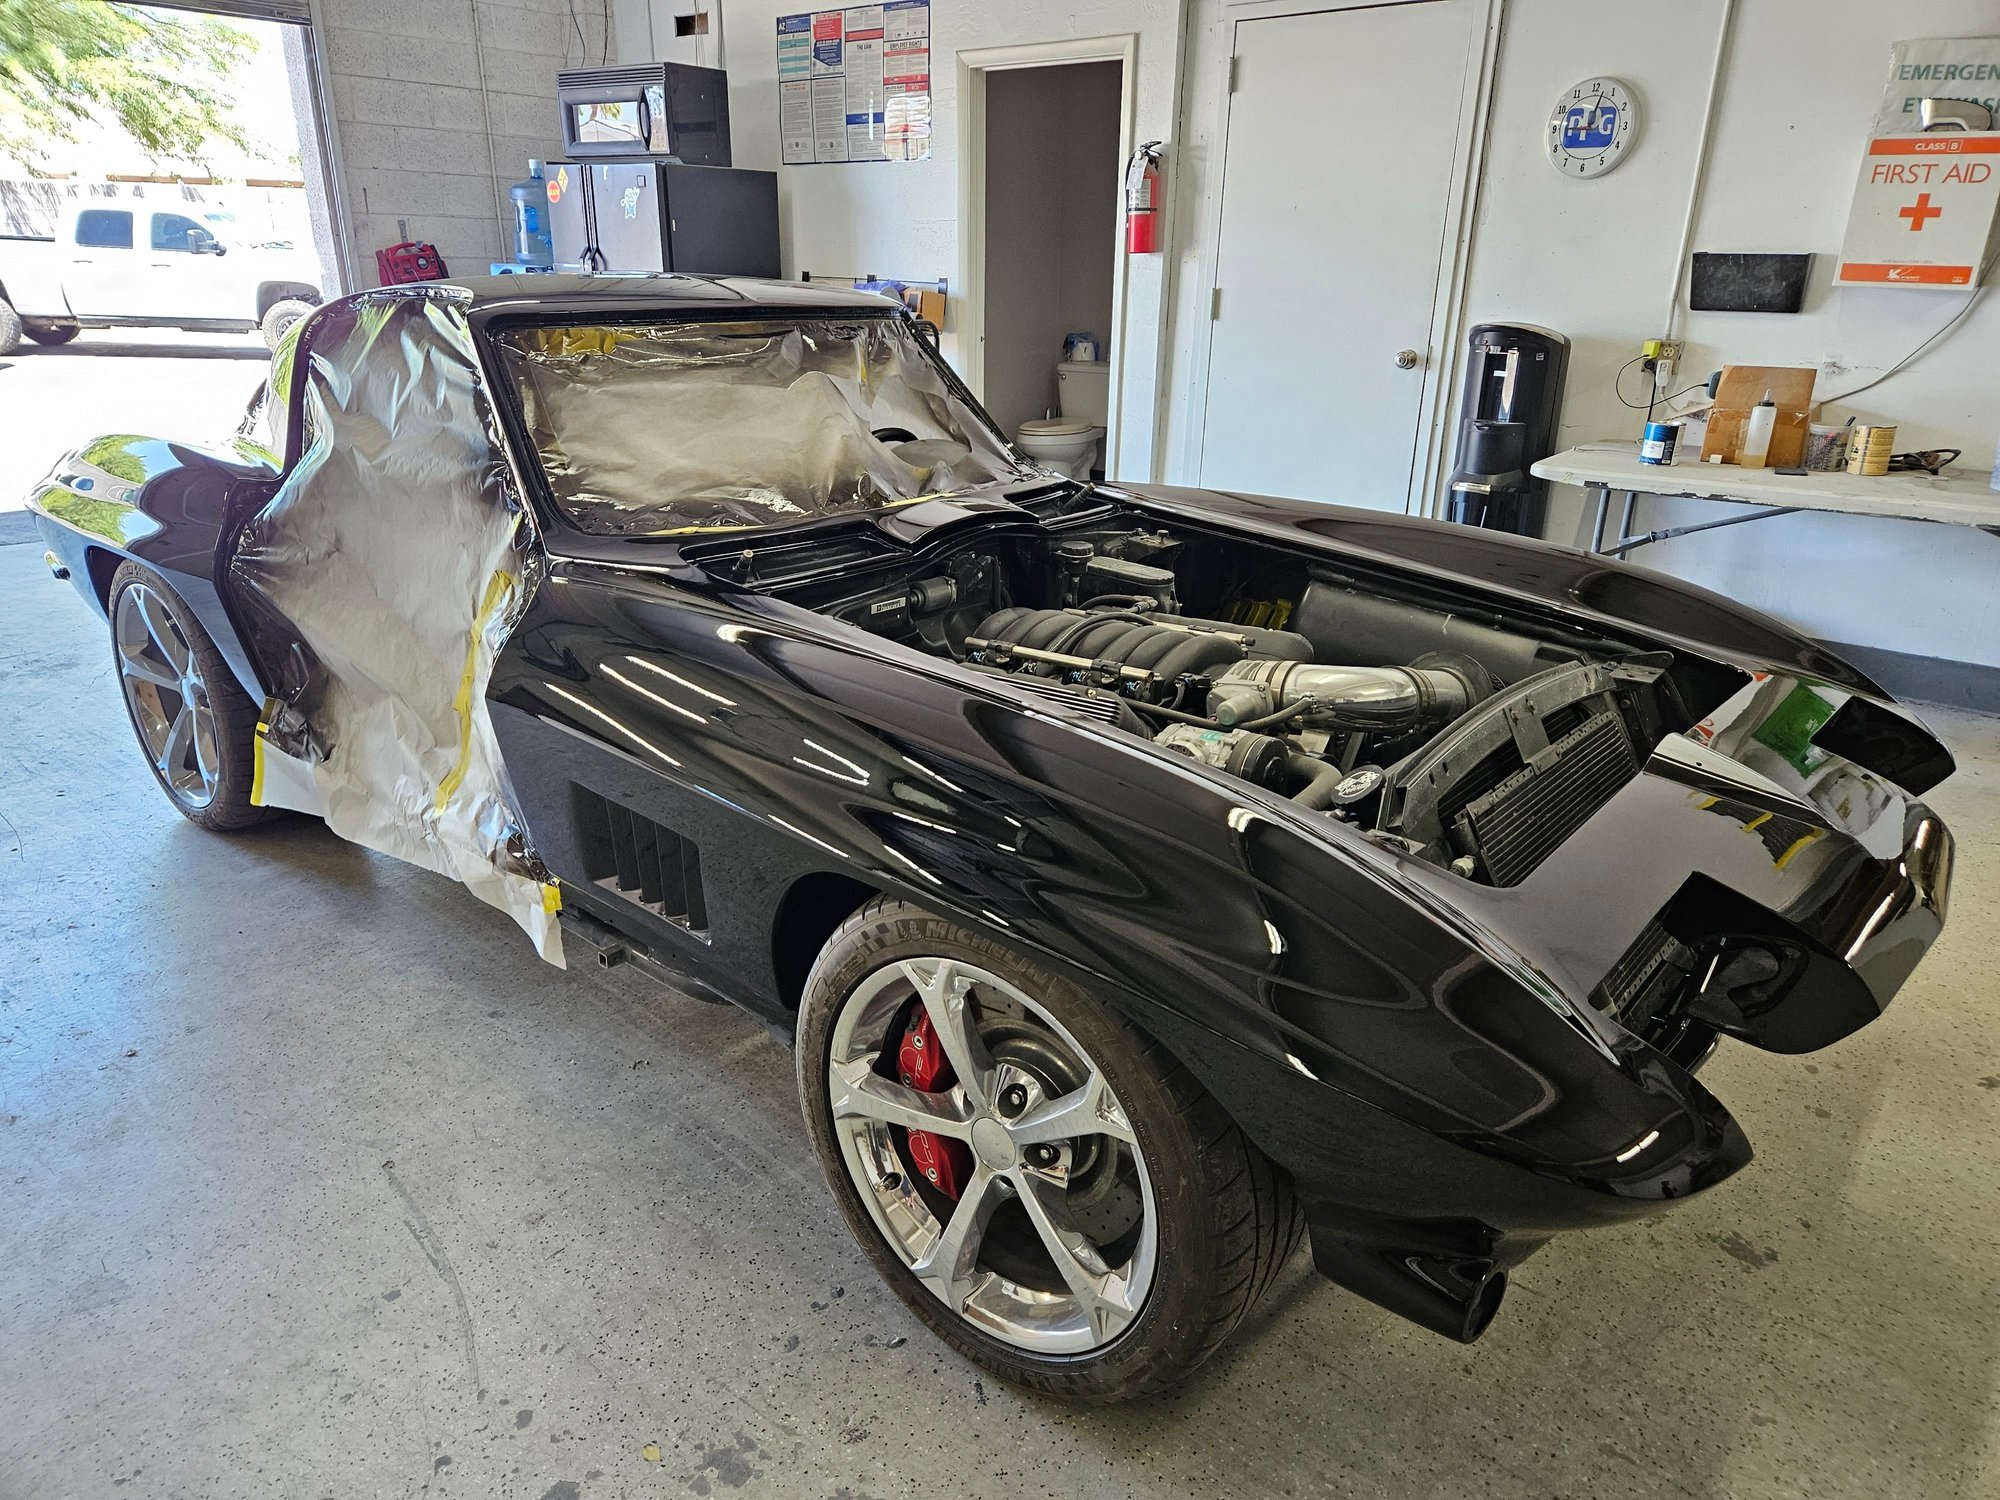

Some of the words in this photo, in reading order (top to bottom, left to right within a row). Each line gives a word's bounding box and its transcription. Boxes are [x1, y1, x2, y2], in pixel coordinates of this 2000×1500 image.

[778, 22, 786, 31] AZ
[909, 40, 923, 48] RIGHTS
[1898, 64, 2000, 81] EMERGEN
[1592, 83, 1600, 92] 12
[1573, 89, 1581, 98] 11
[1611, 88, 1616, 97] 1
[1558, 105, 1567, 115] 10
[1621, 102, 1628, 111] 2
[1567, 108, 1614, 141] PPG
[1622, 122, 1628, 131] 3
[1552, 125, 1557, 134] 9
[1553, 144, 1559, 154] 8
[1615, 141, 1620, 150] 4
[1914, 142, 1946, 151] CLASS
[1950, 142, 1959, 150] B
[1563, 158, 1568, 167] 7
[1599, 156, 1605, 166] 5
[1579, 163, 1585, 173] 6
[1871, 163, 1940, 184] FIRST
[1941, 162, 1992, 184] AID
[926, 920, 1050, 987] MICHELIN
